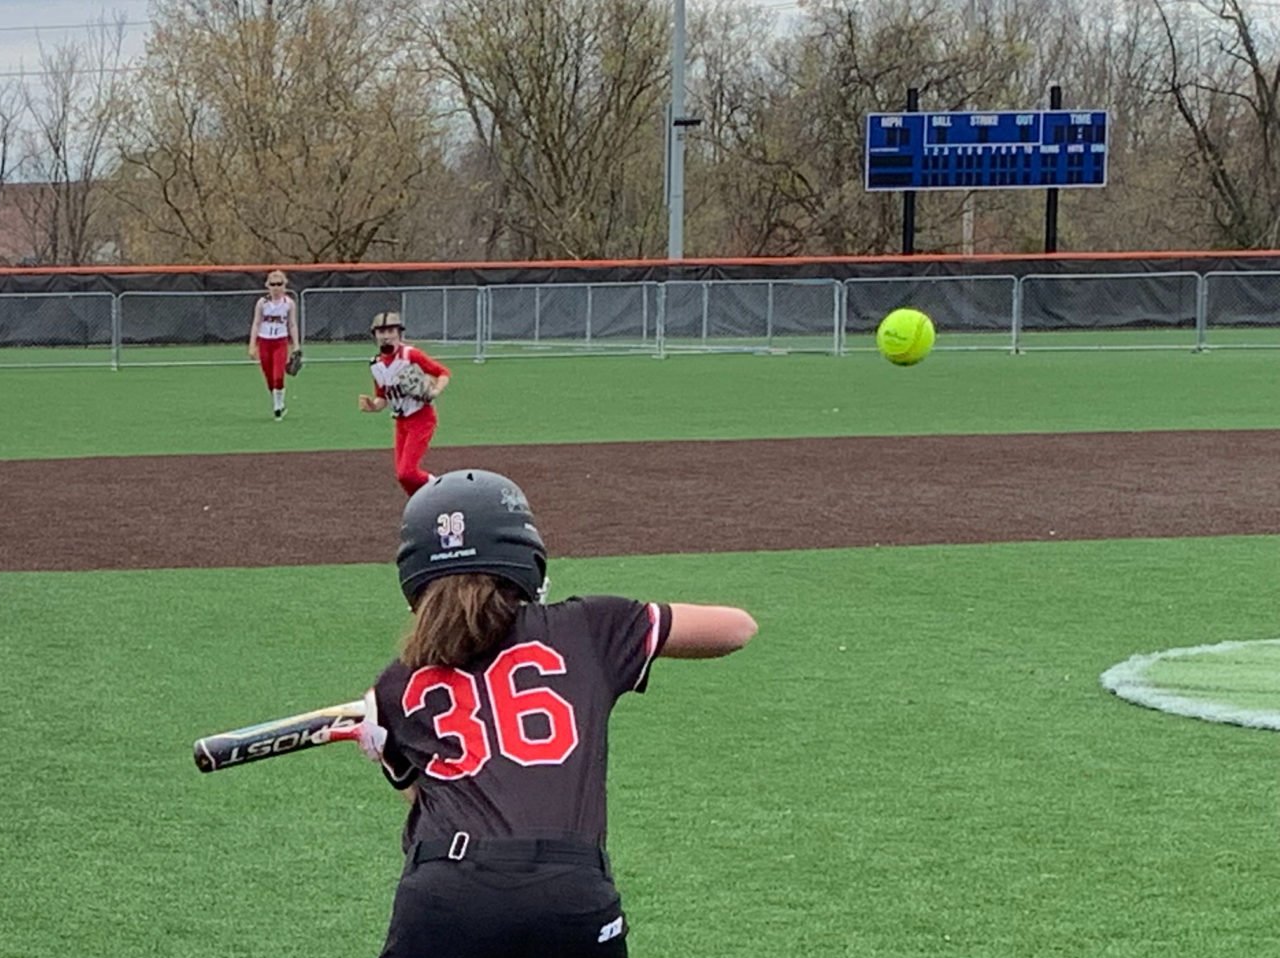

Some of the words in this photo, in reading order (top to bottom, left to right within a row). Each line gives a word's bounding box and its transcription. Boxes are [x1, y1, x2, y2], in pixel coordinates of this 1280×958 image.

[932, 116, 952, 127] BALL
[1016, 115, 1034, 126] OUT
[1070, 113, 1092, 125] TIME
[436, 511, 466, 537] 36
[402, 640, 579, 781] 36
